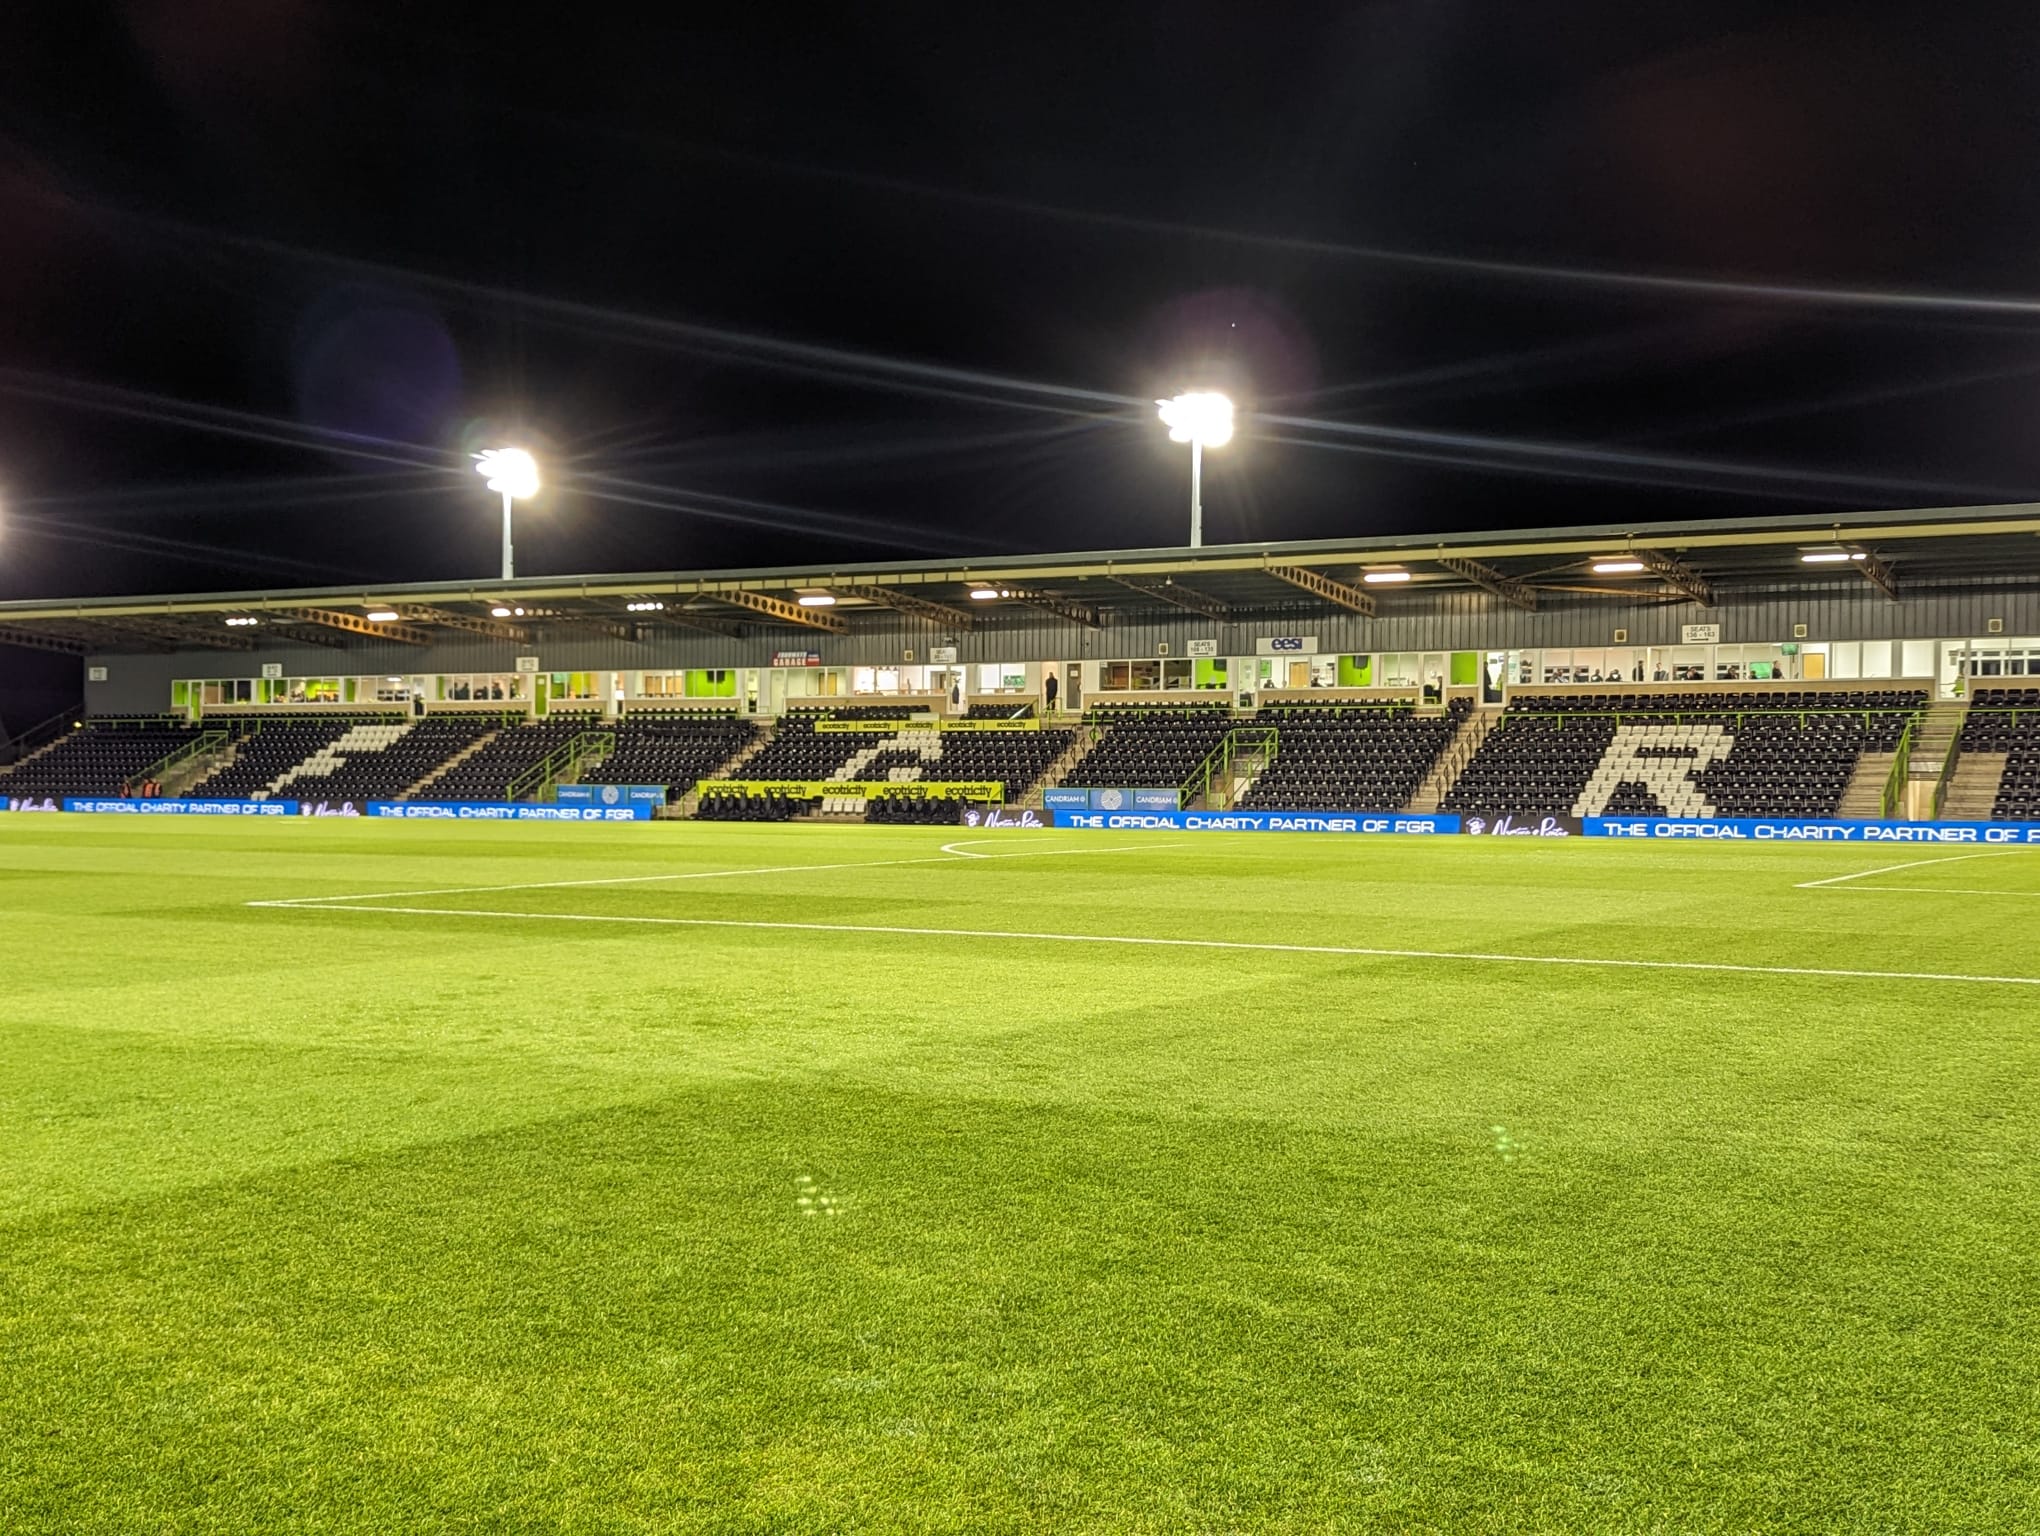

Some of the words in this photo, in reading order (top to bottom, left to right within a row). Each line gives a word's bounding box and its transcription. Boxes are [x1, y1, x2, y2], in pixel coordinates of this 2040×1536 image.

[822, 722, 850, 730] ecotricity
[863, 722, 891, 730] ecotricity
[905, 721, 934, 729] ecotricity
[947, 721, 977, 729] ecotricity
[996, 720, 1026, 729] ecotricity
[822, 785, 867, 796] ecotricity
[883, 785, 929, 796] ecotricity
[945, 786, 993, 797] ecotricity
[1136, 796, 1172, 804] CANDRIAM
[73, 801, 94, 811] THE
[95, 802, 139, 812] OFFICIAL
[140, 803, 187, 812] CHARITY
[189, 803, 240, 812] PARTNER
[242, 804, 258, 814] OF
[260, 804, 285, 814] FGR
[379, 806, 403, 816] THE
[406, 806, 456, 817] OFFICIAL
[459, 807, 515, 817] CHARITY
[519, 808, 580, 819] PARTNER
[582, 808, 603, 819] OF
[605, 809, 635, 819] FGR
[1070, 815, 1103, 828] THE
[1108, 816, 1180, 829] OFFICIAL
[1185, 817, 1264, 830] CHARITY
[1269, 818, 1356, 832] PARTNER
[1362, 819, 1390, 832] OF
[1395, 820, 1436, 833] FGR
[1603, 823, 1648, 837] THE
[1654, 824, 1747, 838] OFFICIAL
[1754, 825, 1856, 840] CHARITY
[1863, 826, 1977, 841] PARTNER
[1985, 828, 2020, 842] OF
